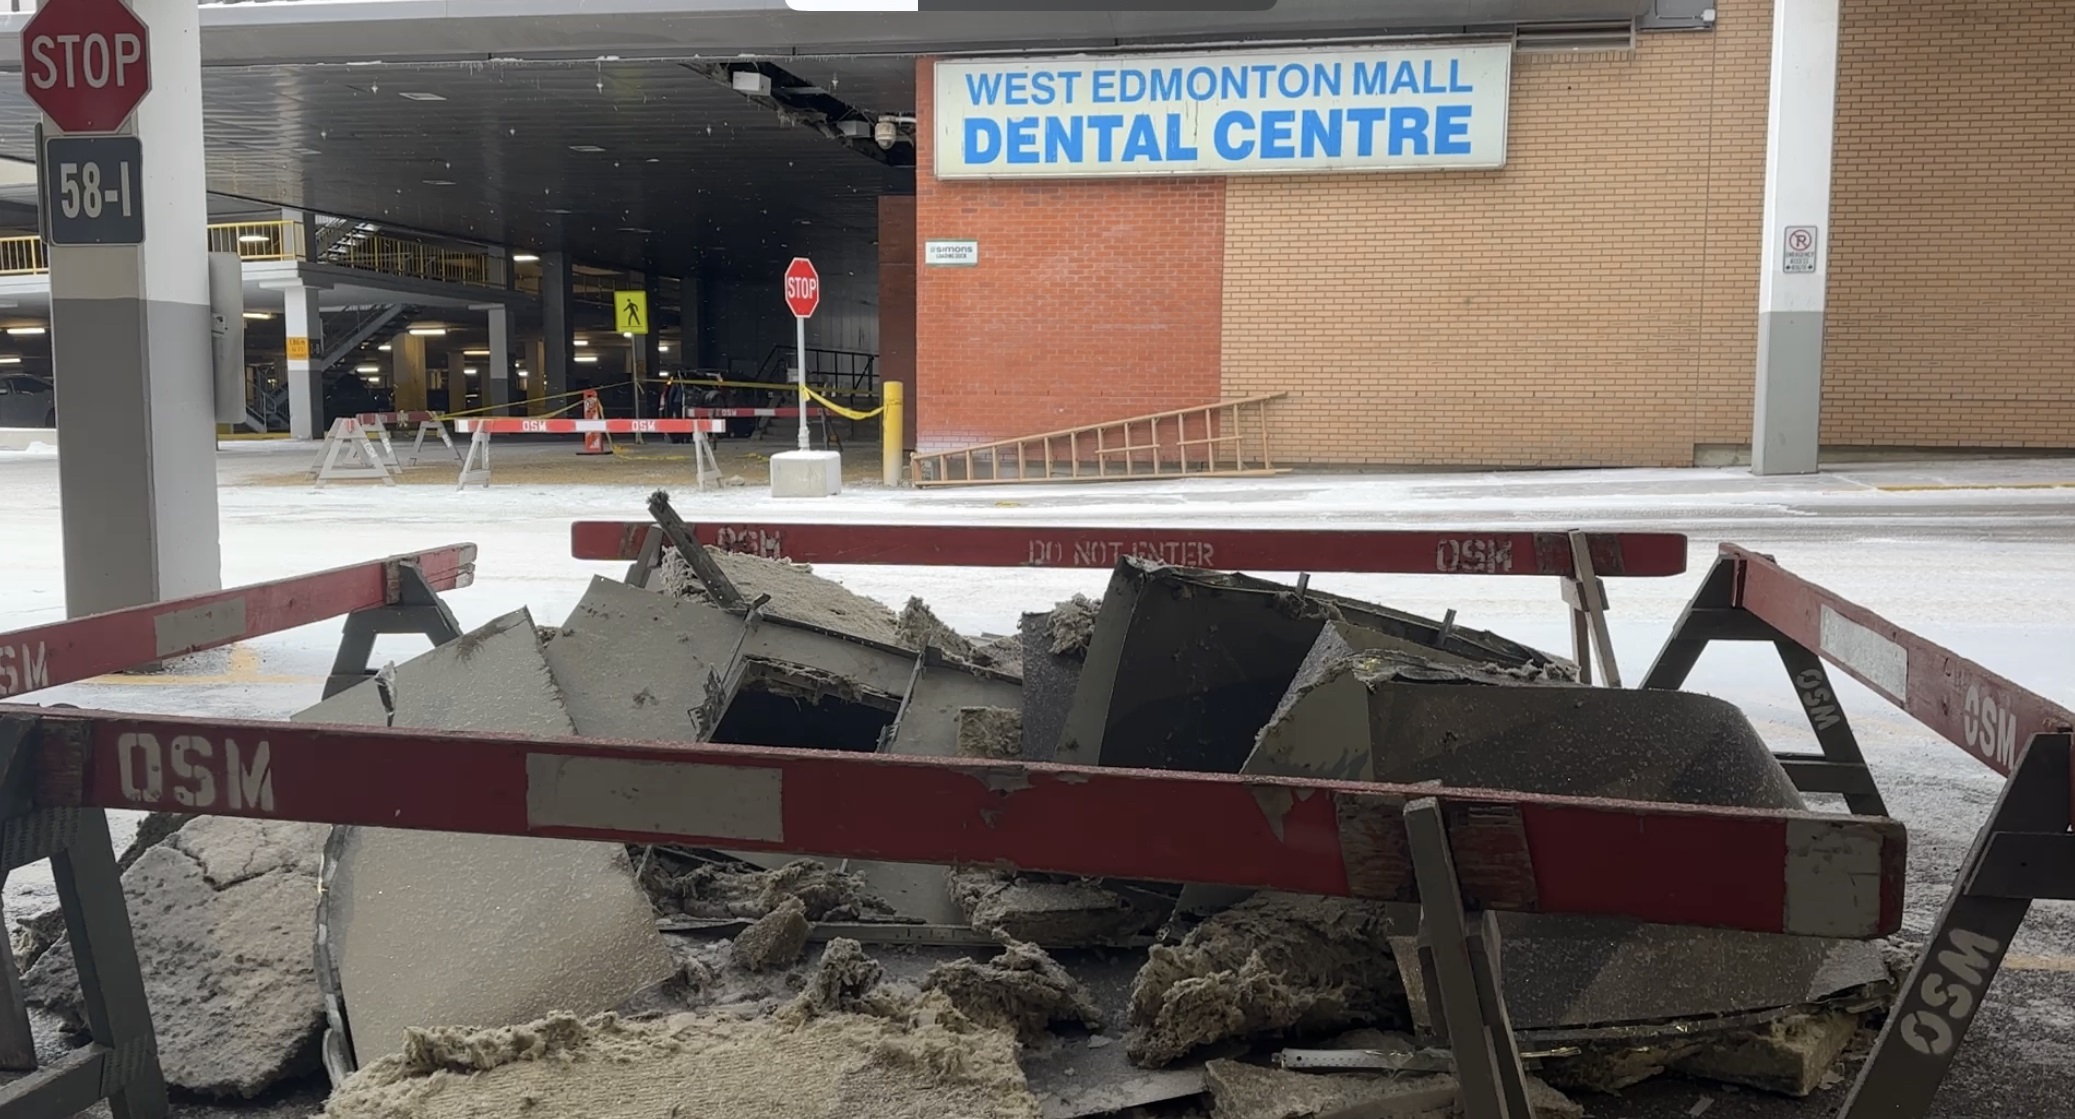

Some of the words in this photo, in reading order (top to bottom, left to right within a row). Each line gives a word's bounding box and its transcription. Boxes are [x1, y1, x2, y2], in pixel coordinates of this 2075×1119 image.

[30, 32, 141, 89] STOP
[965, 71, 1082, 105] WEST
[1091, 62, 1342, 103] EDMONTON
[1353, 58, 1474, 96] MALL
[963, 112, 1199, 165] DENTAL
[1212, 104, 1473, 162] CENTRE
[788, 276, 817, 299] STOP
[522, 420, 547, 431] OSM
[631, 420, 656, 431] OSM
[1028, 539, 1063, 566] DO
[1073, 540, 1124, 566] NOT
[1132, 541, 1215, 567] ENTER
[1436, 539, 1513, 573] OSM
[1796, 668, 1841, 730] OSM
[1964, 684, 2018, 770] OSM
[117, 732, 275, 811] OSM
[1900, 927, 1999, 1055] OSM
